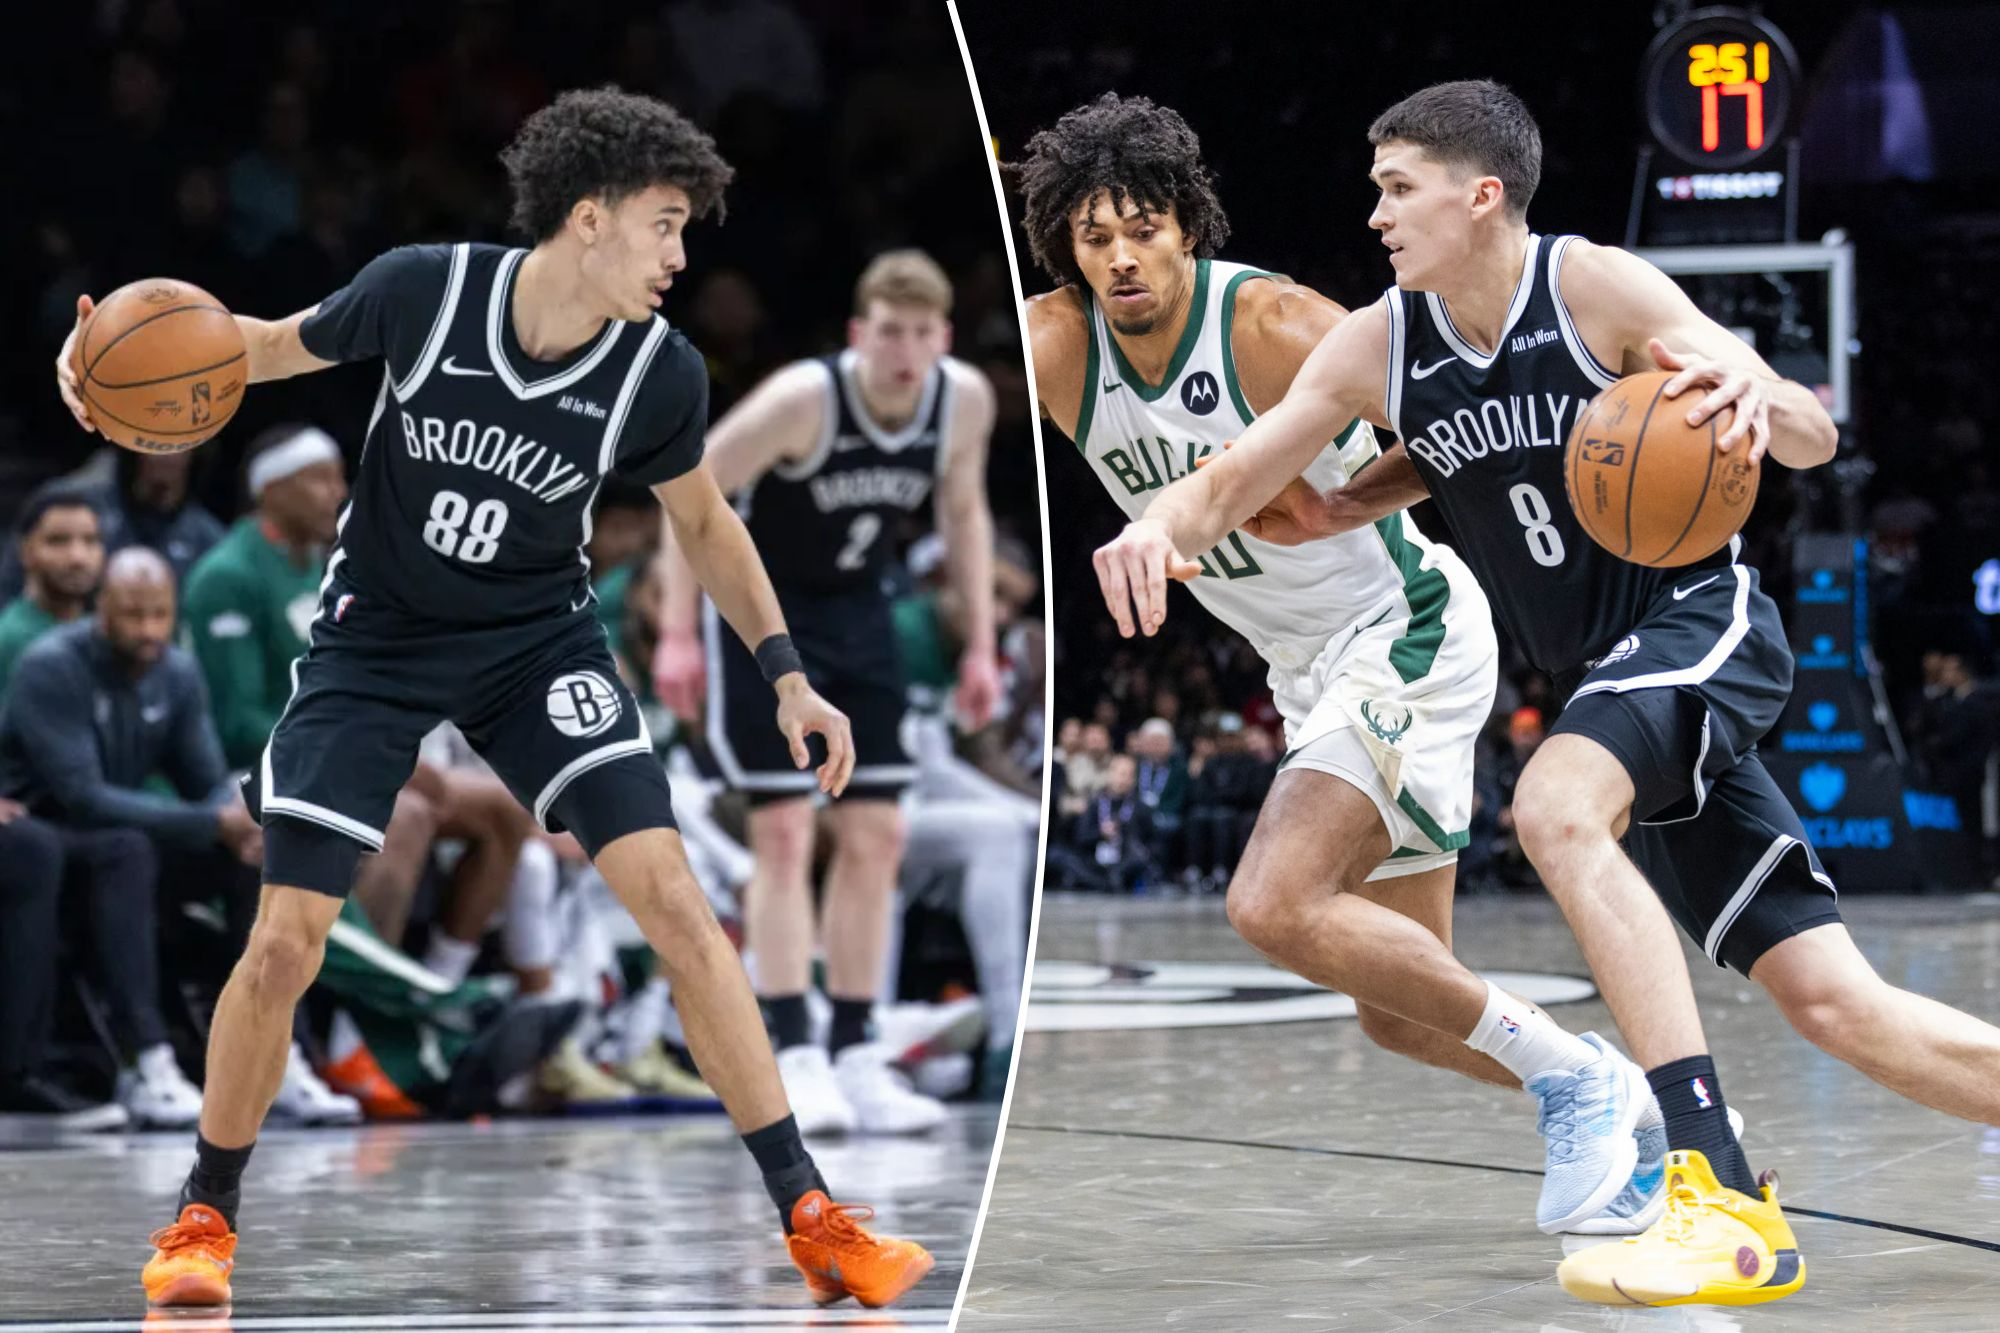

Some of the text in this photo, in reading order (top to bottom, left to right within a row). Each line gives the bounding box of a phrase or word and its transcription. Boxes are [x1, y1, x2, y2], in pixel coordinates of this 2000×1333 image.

[1702, 79, 1764, 151] 17
[1534, 329, 1559, 345] Won
[401, 410, 590, 502] BROOKLYN
[422, 489, 510, 564] 88
[834, 512, 882, 571] 2
[1508, 482, 1566, 568] 8
